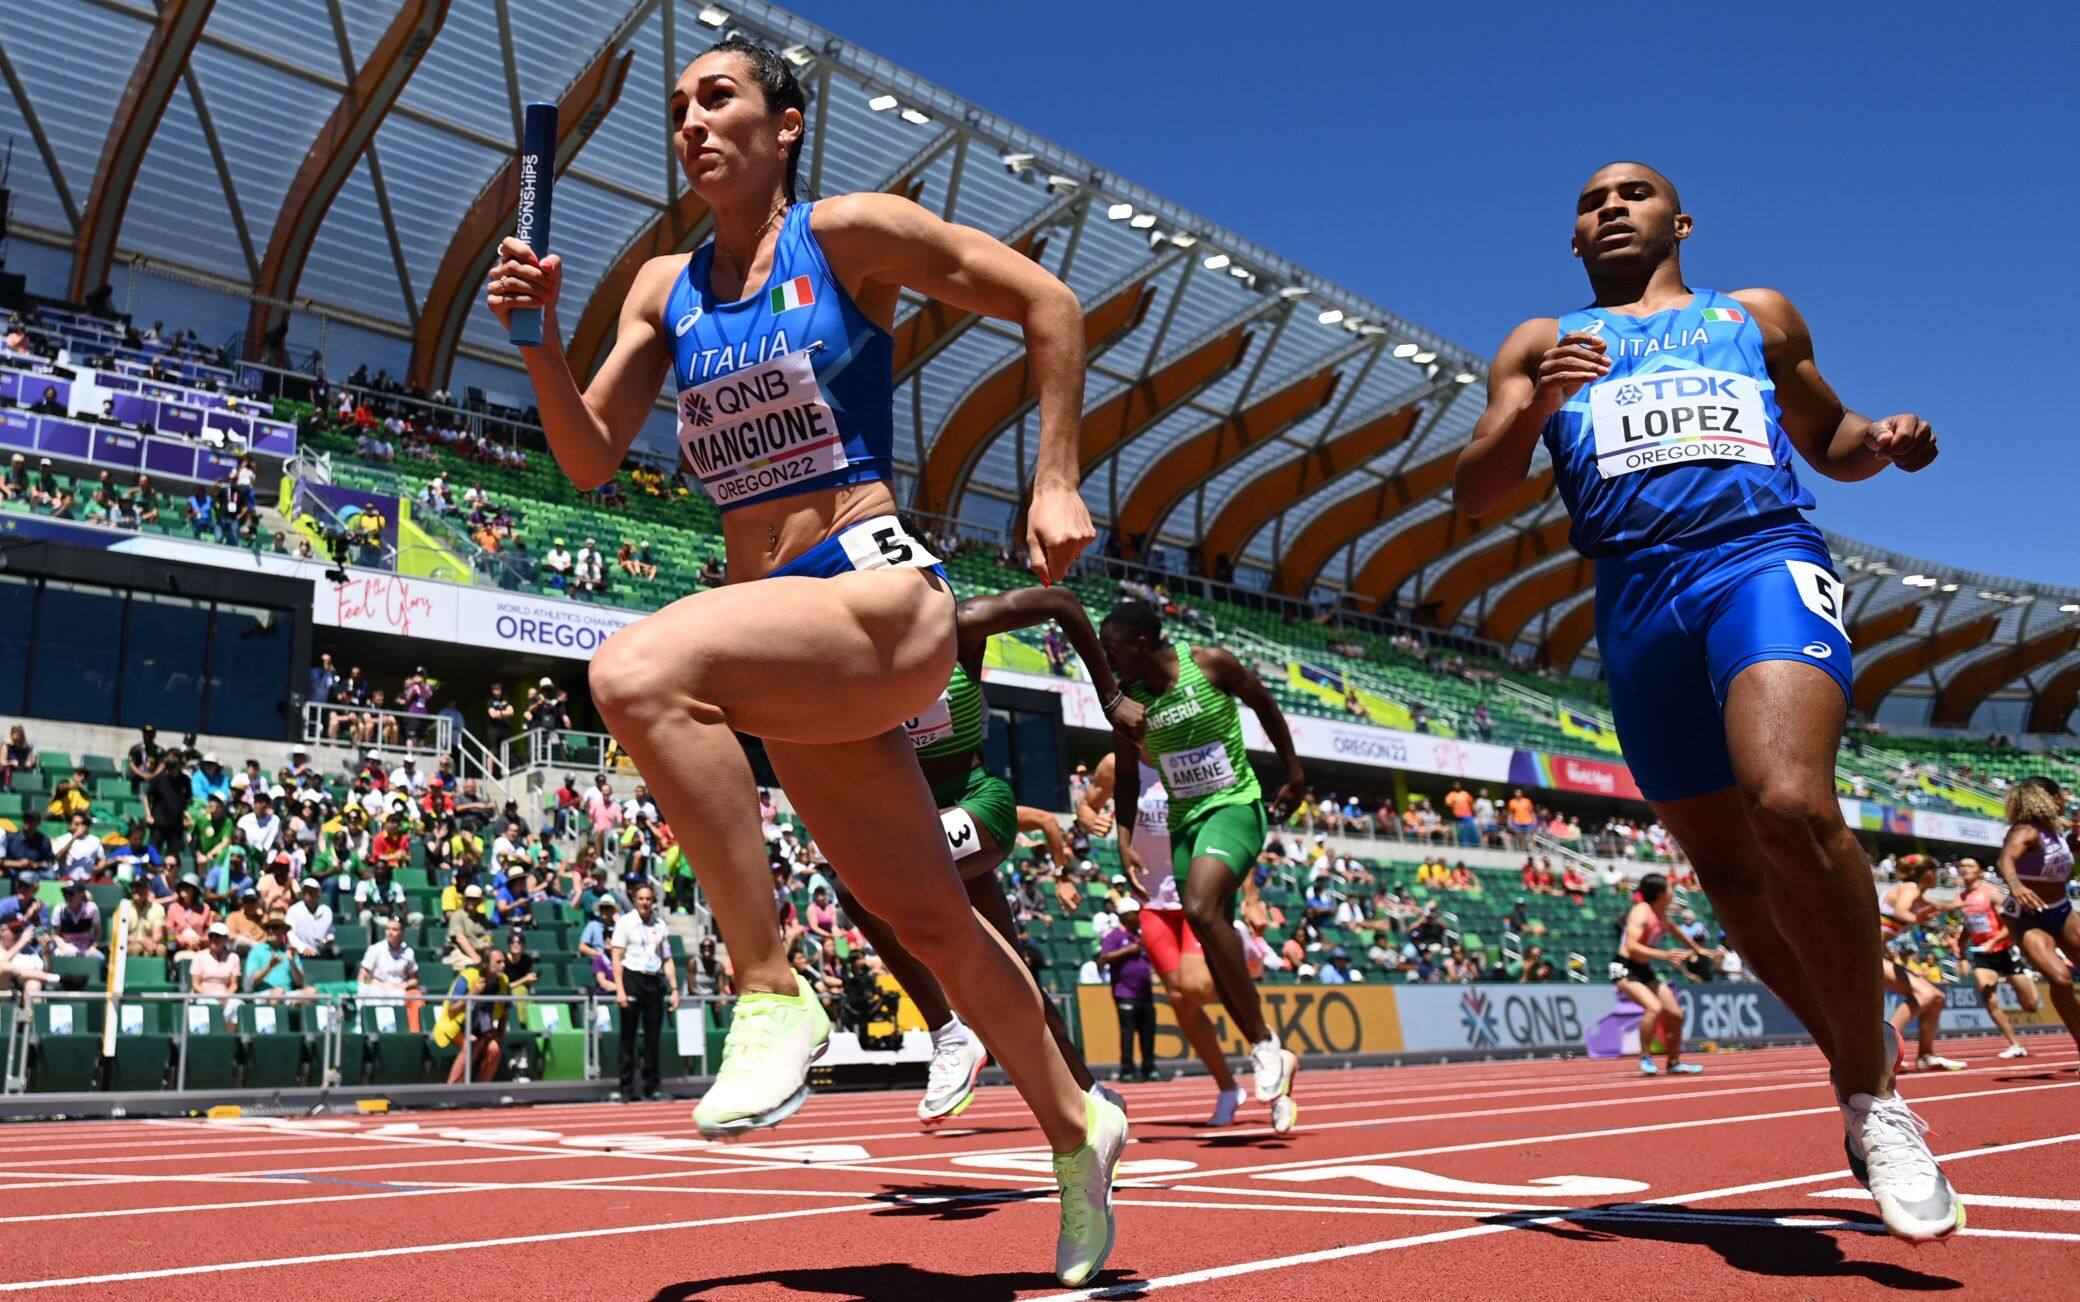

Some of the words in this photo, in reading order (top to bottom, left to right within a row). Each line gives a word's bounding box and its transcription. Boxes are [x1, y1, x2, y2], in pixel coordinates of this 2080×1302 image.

[519, 154, 539, 244] PIONSHIPS
[689, 330, 789, 380] ITALIA
[1619, 327, 1710, 357] ITALIA
[715, 369, 790, 414] QNB
[1642, 376, 1740, 400] TDK
[689, 403, 828, 474] MANGIONE
[1622, 405, 1743, 443] LOPEZ
[1626, 443, 1747, 469] OREGON22
[717, 456, 817, 500] OREGON22
[871, 527, 913, 566] 5
[496, 602, 531, 616] WORLD
[533, 608, 582, 622] ATHLETICS
[583, 615, 628, 629] CHAMPIO
[1814, 573, 1838, 620] 5
[1146, 699, 1204, 731] NIGERIA
[1173, 761, 1225, 785] AMENE
[1177, 747, 1215, 766] TDK
[948, 824, 971, 848] 3
[1152, 990, 1362, 1059] SKO
[1504, 994, 1584, 1044] QNB
[1250, 1165, 1650, 1197] 2
